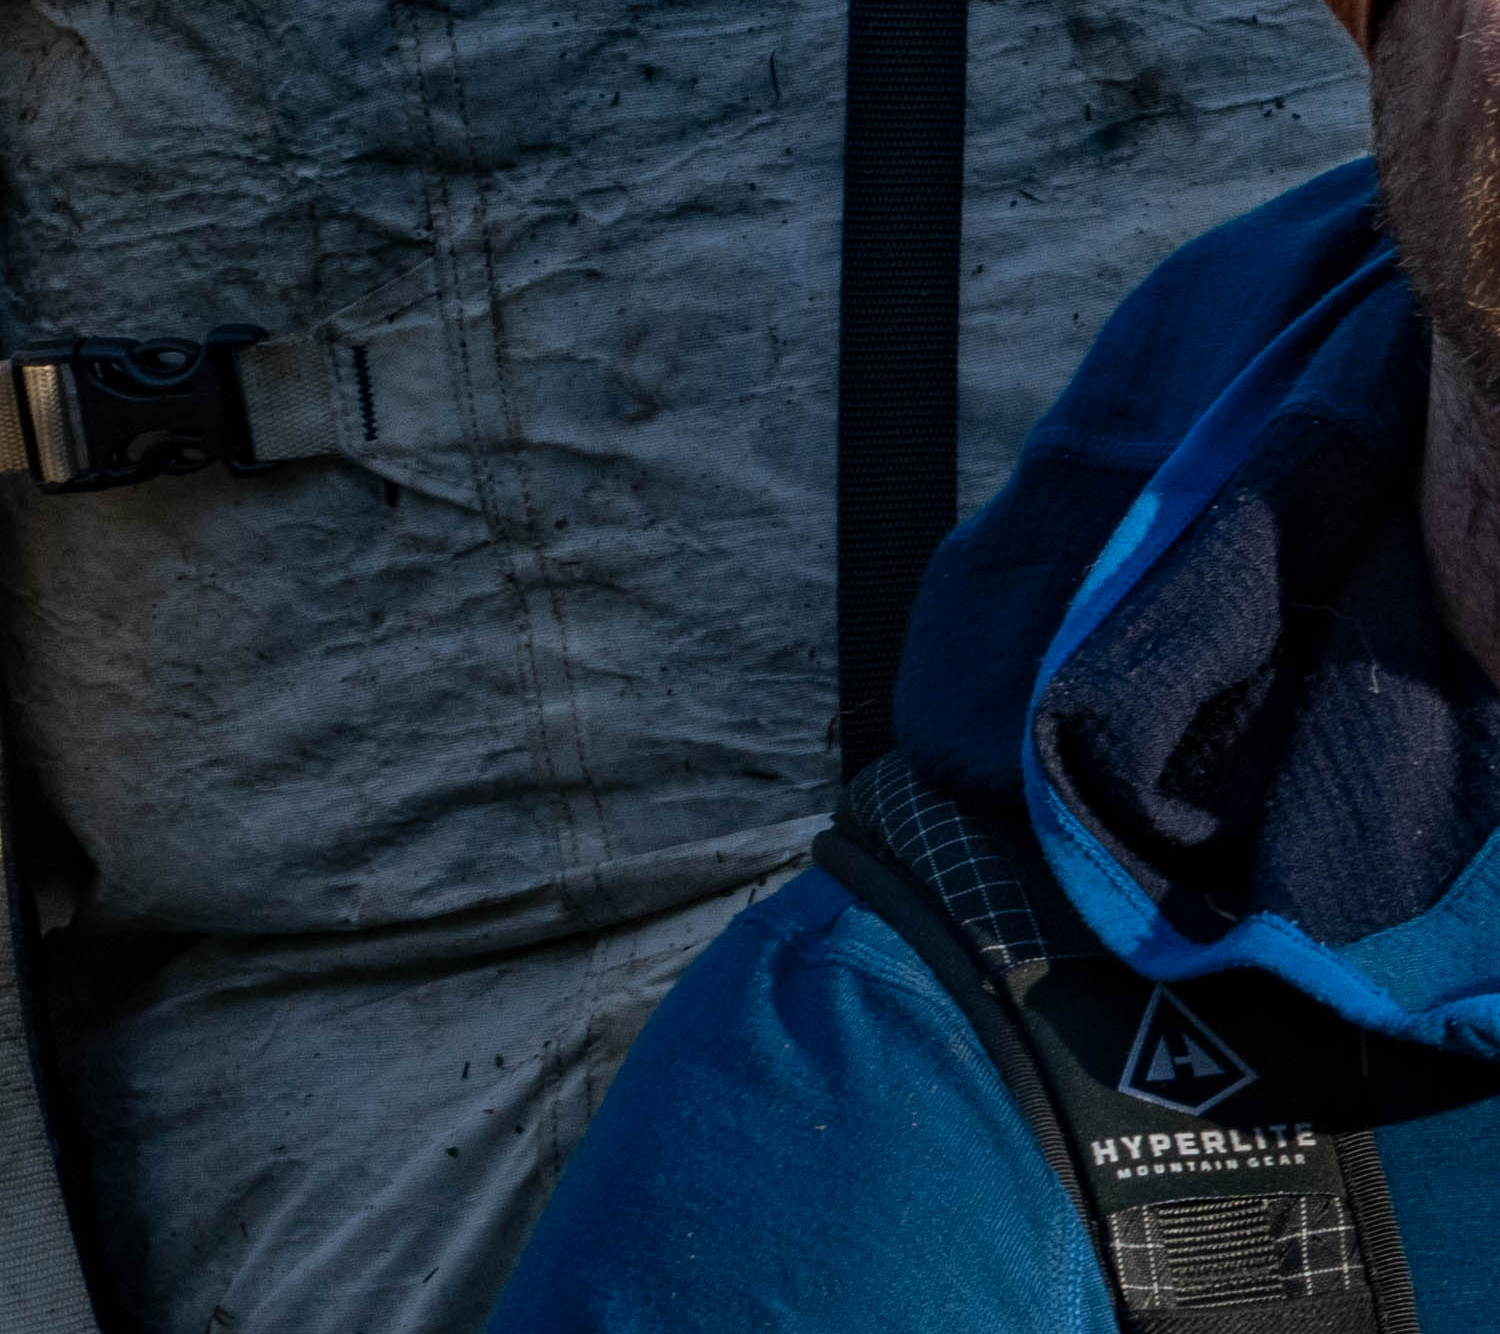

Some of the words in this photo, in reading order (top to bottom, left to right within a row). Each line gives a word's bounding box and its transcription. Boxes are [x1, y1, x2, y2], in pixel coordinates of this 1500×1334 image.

[1091, 1123, 1317, 1165] HYPERLITE
[1116, 1160, 1239, 1180] MOUNTAIN
[1246, 1153, 1306, 1168] GEAR
